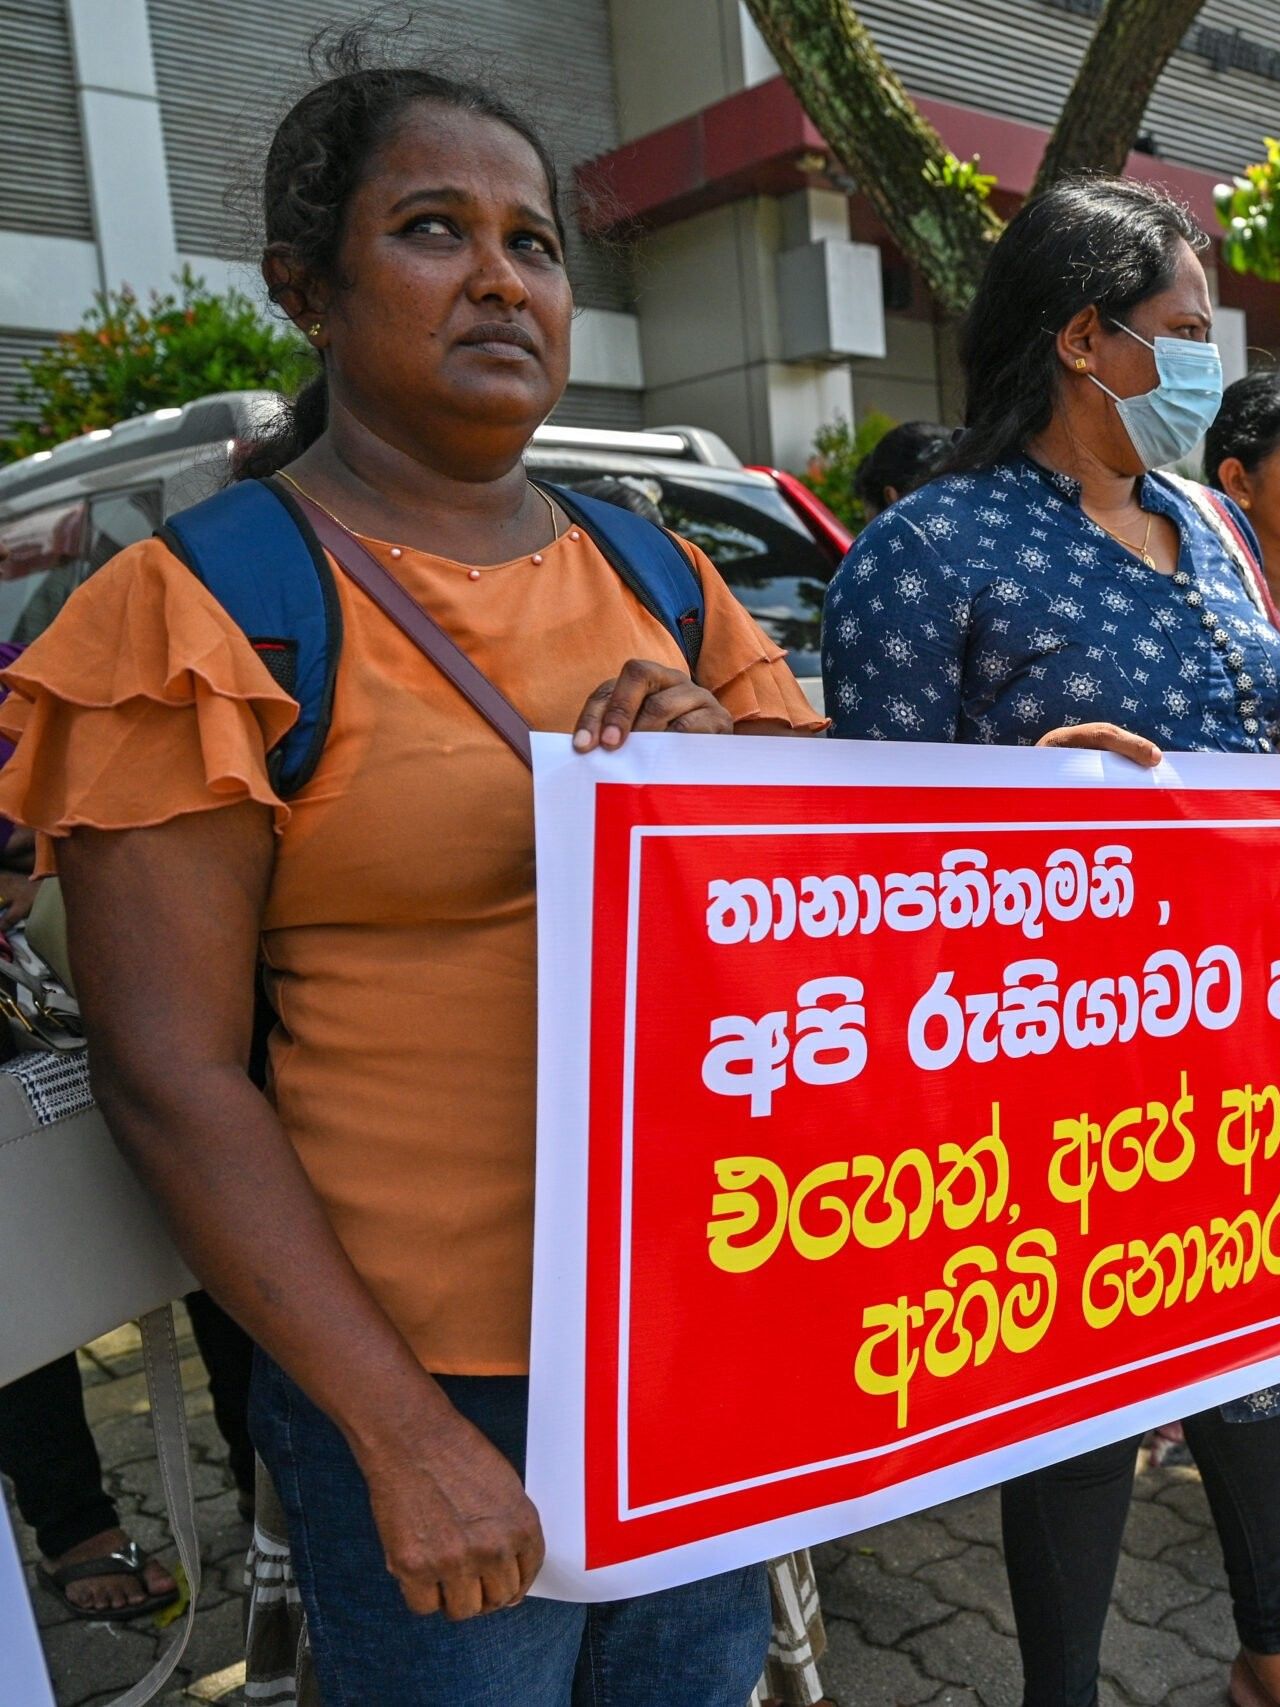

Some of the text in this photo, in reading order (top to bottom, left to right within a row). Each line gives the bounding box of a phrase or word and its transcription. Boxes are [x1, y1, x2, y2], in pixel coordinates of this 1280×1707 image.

[706, 845, 1134, 944] තානාපතිතුමනි
[701, 976, 868, 1118] අපි
[907, 944, 1242, 1071] රුසියාවට
[1047, 1070, 1196, 1235] අපේ
[854, 1228, 1058, 1429] අහිමි
